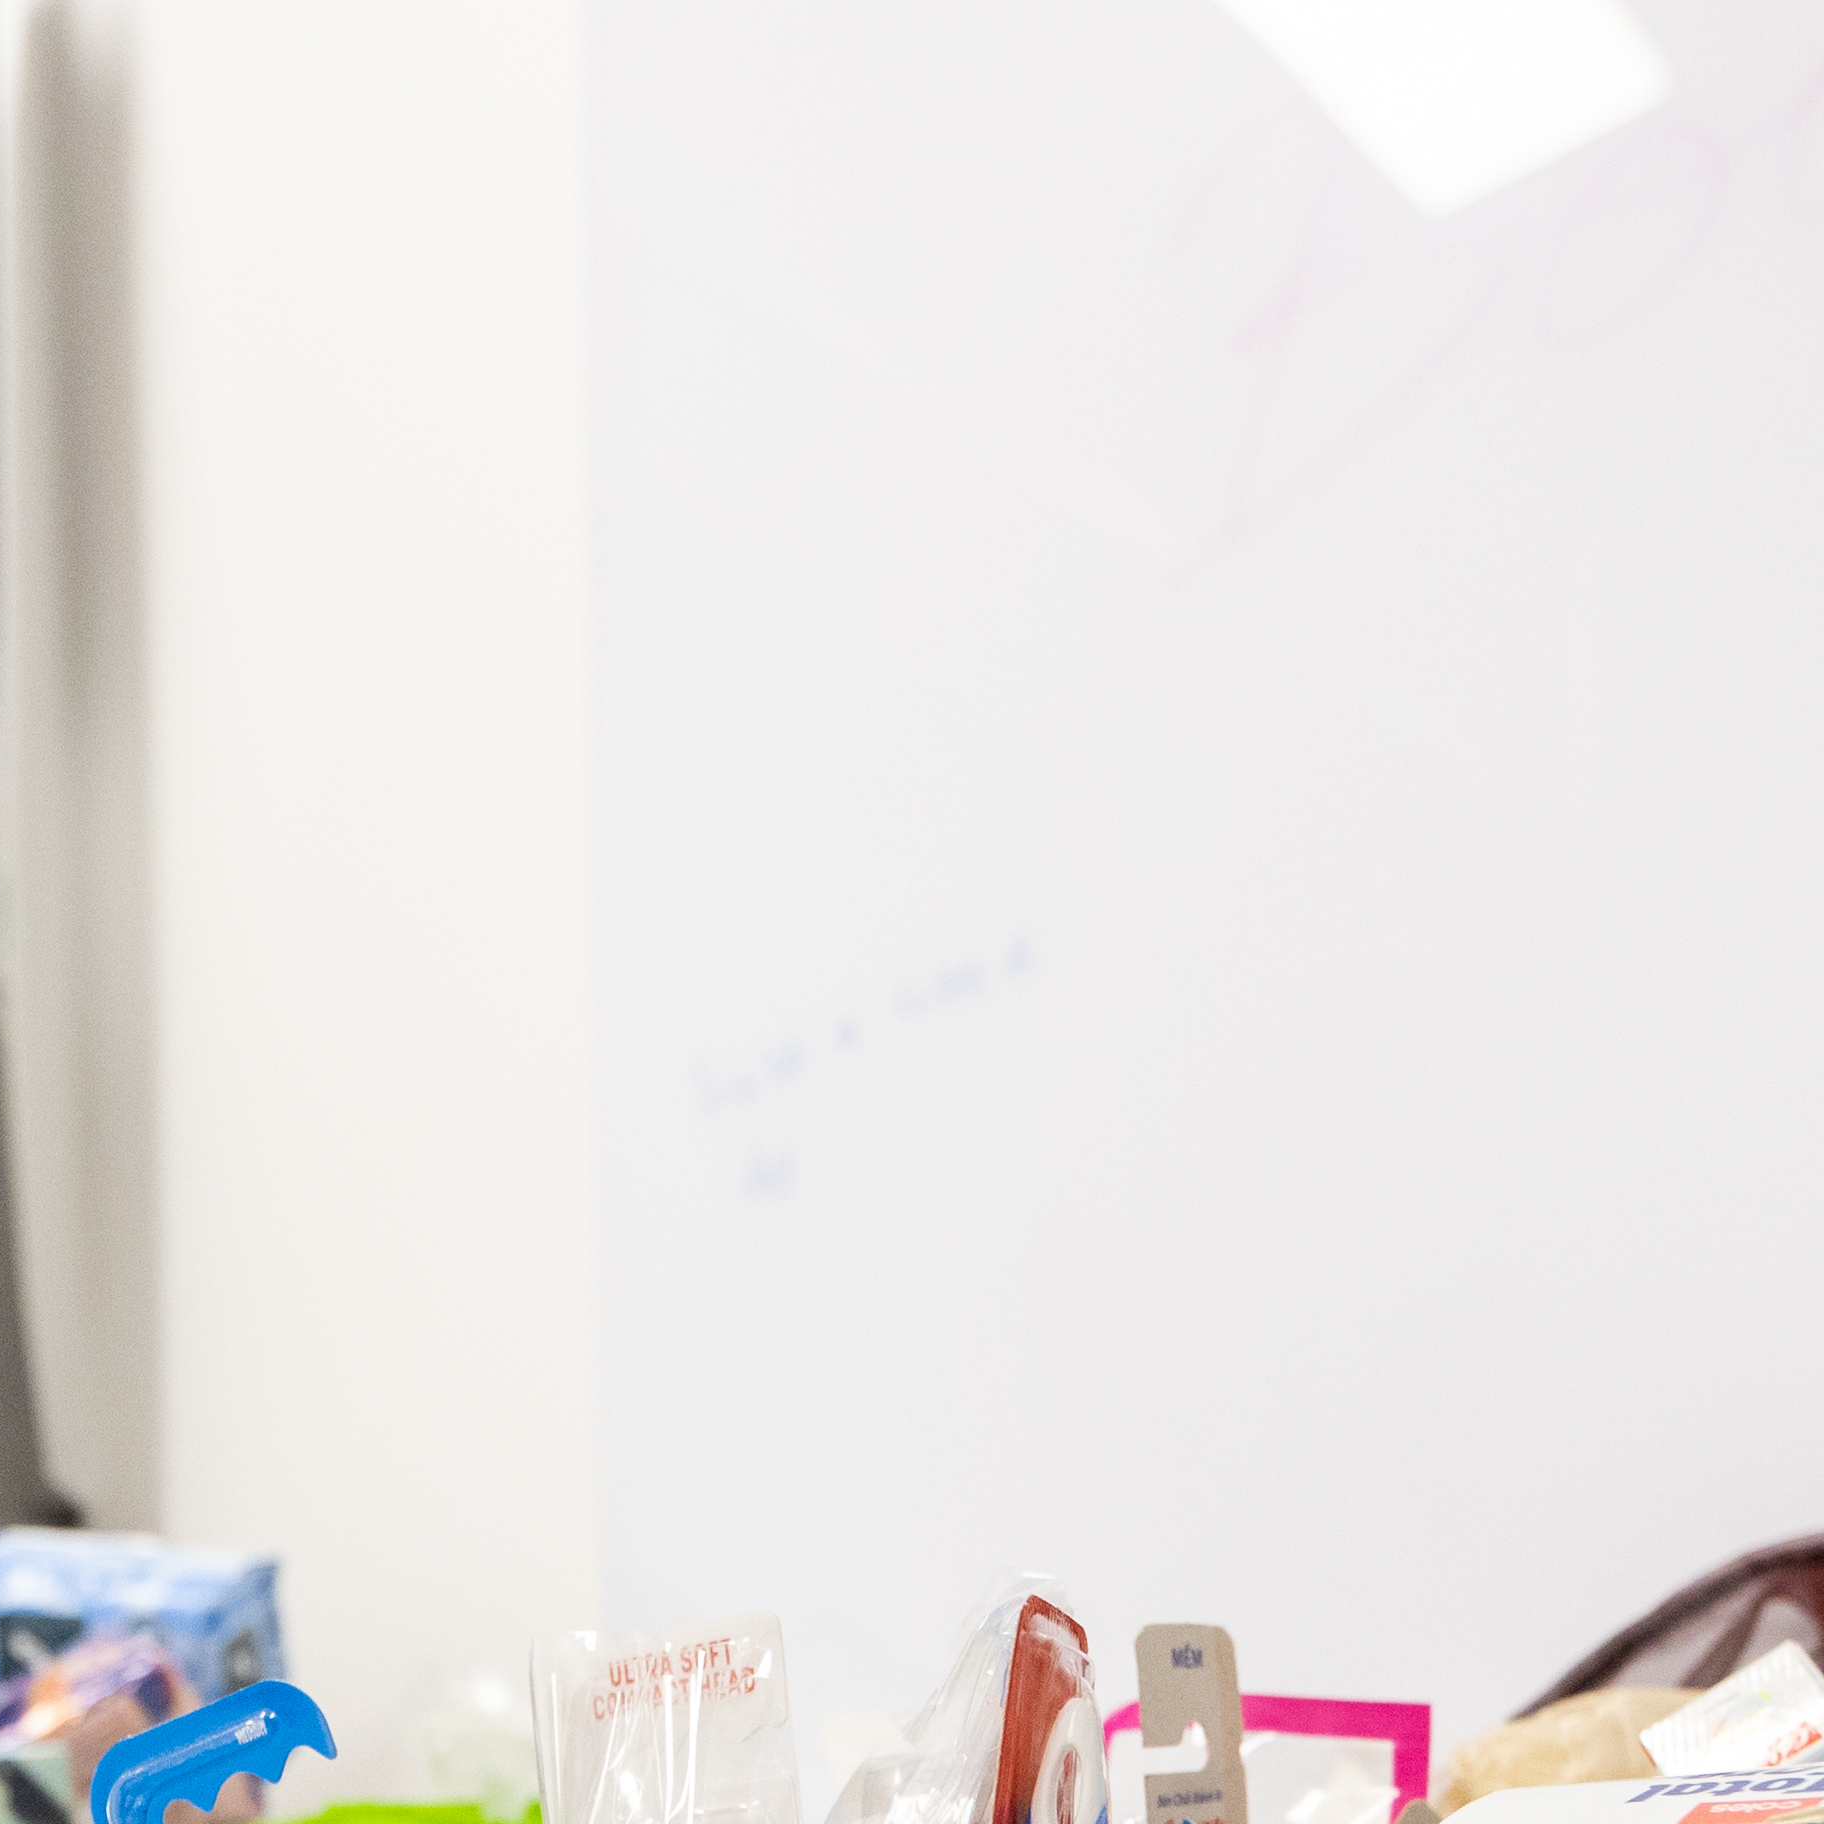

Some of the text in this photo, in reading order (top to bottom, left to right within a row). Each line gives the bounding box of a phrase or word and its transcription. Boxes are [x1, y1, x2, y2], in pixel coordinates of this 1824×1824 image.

[608, 1637, 732, 1688] ULTRA SOFT
[592, 1677, 692, 1721] COMACT
